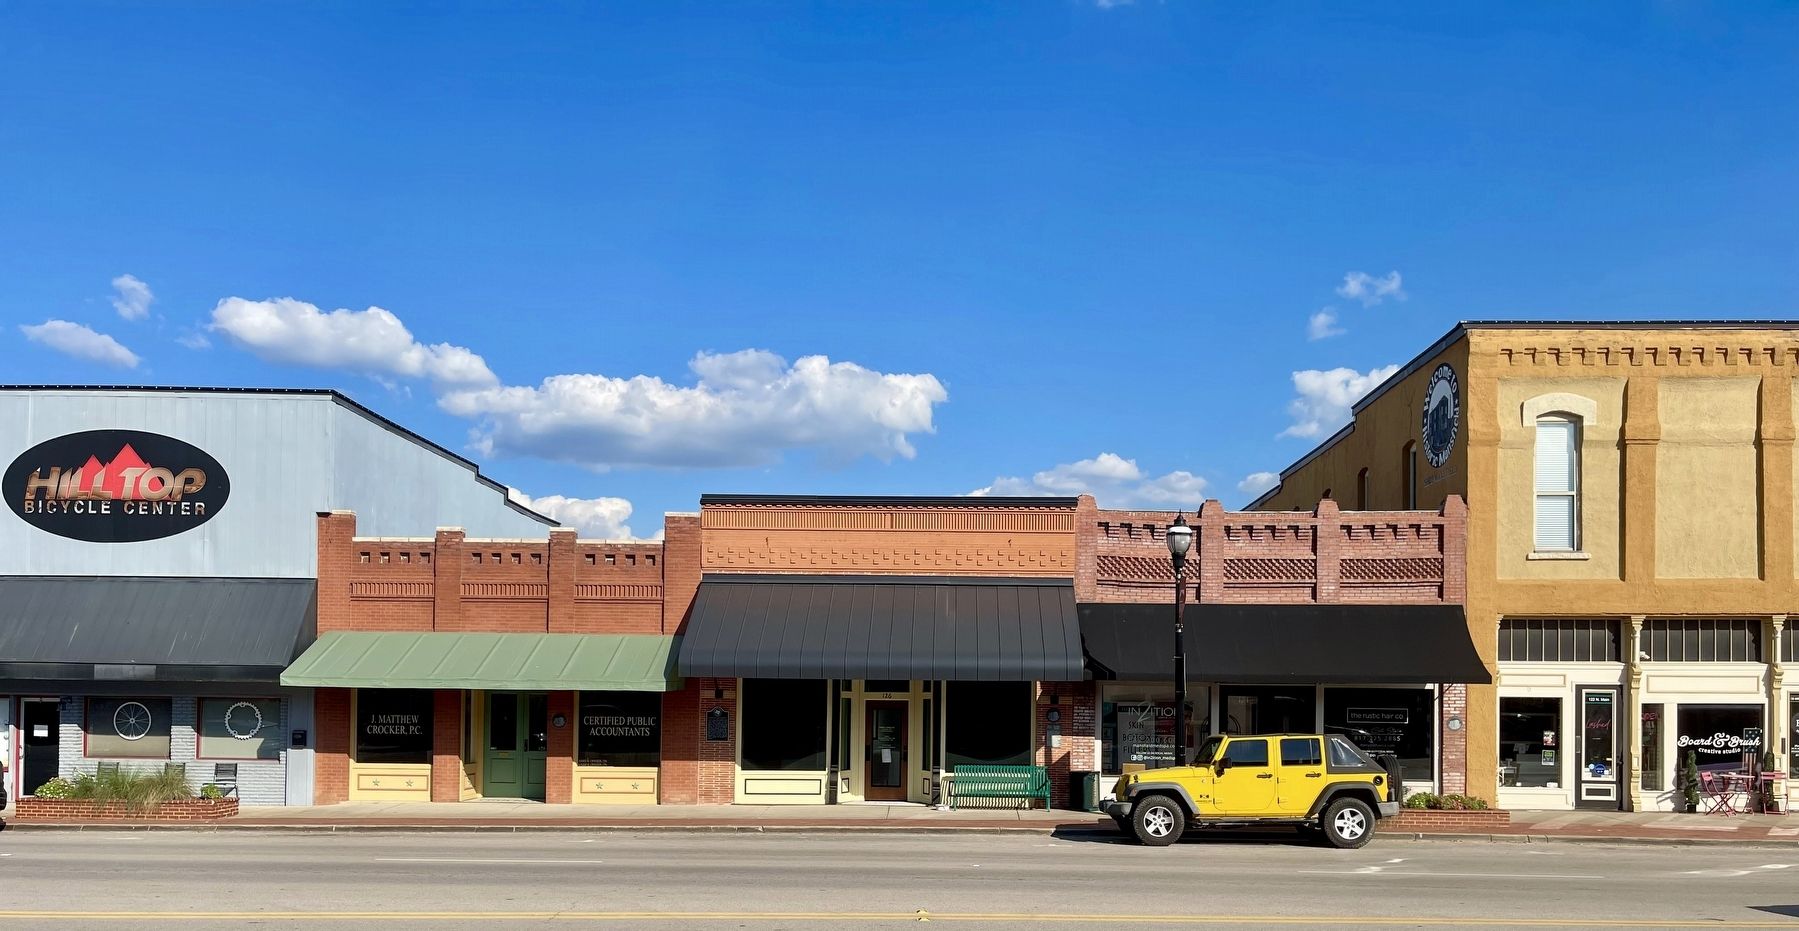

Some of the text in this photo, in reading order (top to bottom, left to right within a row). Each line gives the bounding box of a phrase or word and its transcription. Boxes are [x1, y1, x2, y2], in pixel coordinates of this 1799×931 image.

[1423, 365, 1452, 411] Welcome
[24, 500, 206, 515] BICYCLE CENTER
[1128, 701, 1176, 722] IN2ITIO
[1381, 712, 1393, 720] hair
[371, 714, 419, 724] J. MATTHEW
[583, 716, 656, 726] CERTIFIED PUBLIC
[1128, 720, 1144, 729] SKIN
[366, 725, 423, 735] CROCKER, P.C.
[589, 726, 650, 737] ACCOUNTANTS
[1677, 732, 1762, 748] Board & Brush
